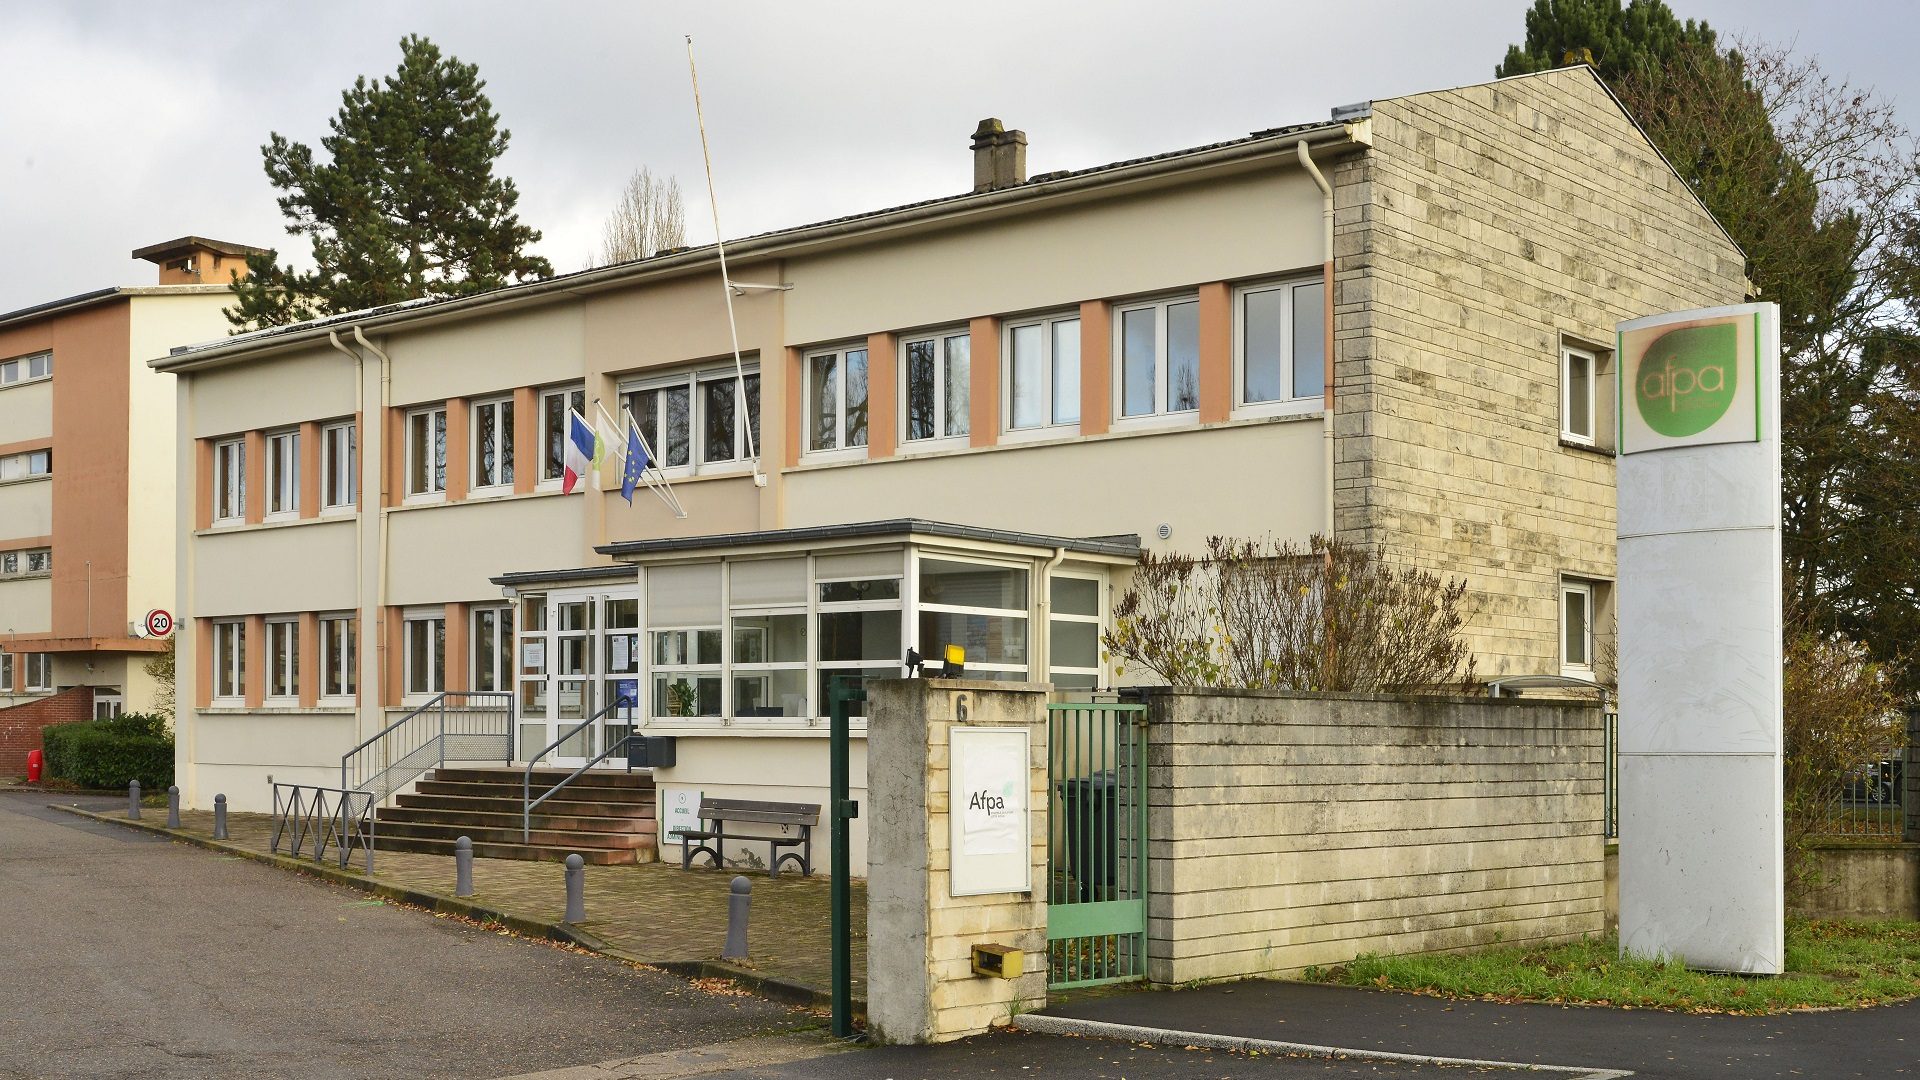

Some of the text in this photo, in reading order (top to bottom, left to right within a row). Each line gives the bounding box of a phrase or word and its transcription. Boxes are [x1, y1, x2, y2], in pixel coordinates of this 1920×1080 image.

[1642, 354, 1724, 413] afpa
[153, 617, 168, 628] 20
[956, 694, 968, 722] 6
[969, 789, 1004, 816] Afpa
